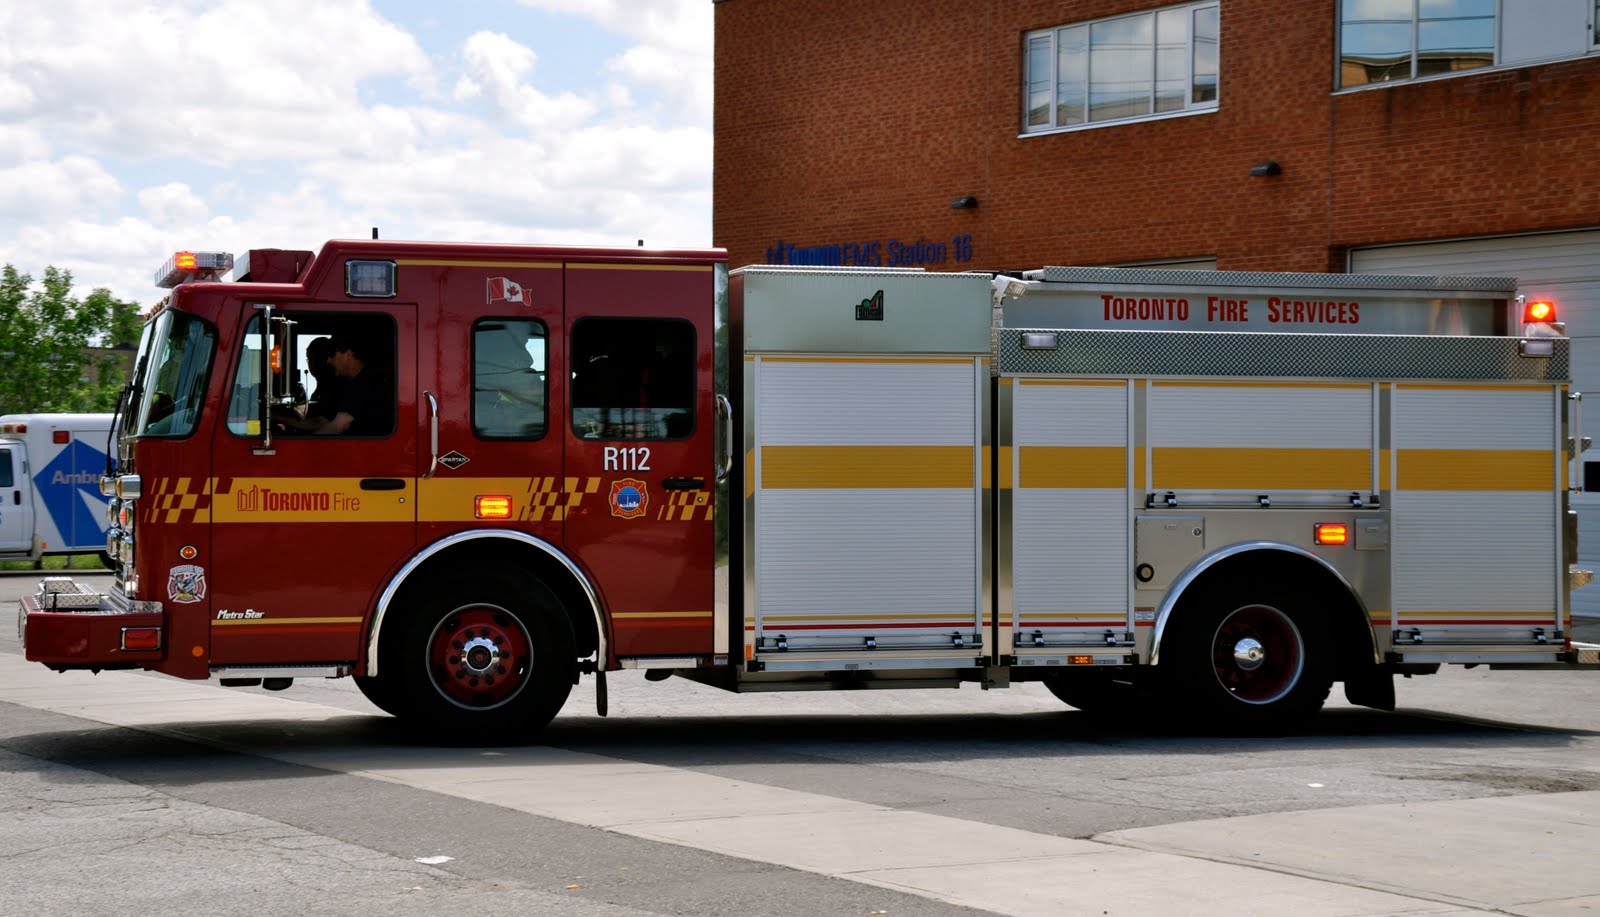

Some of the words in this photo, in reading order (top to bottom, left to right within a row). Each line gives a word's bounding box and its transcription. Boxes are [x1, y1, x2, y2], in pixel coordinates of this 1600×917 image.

[843, 240, 882, 266] EMS
[886, 237, 946, 267] Station
[953, 233, 973, 262] 16
[1101, 295, 1189, 321] TORONTO
[1207, 296, 1249, 322] FIRE
[1267, 296, 1360, 324] SERVICES
[604, 447, 650, 471] R112
[261, 488, 330, 511] TORONTO
[333, 492, 360, 511] Fire
[216, 609, 245, 619] Metro
[244, 609, 265, 619] Star
